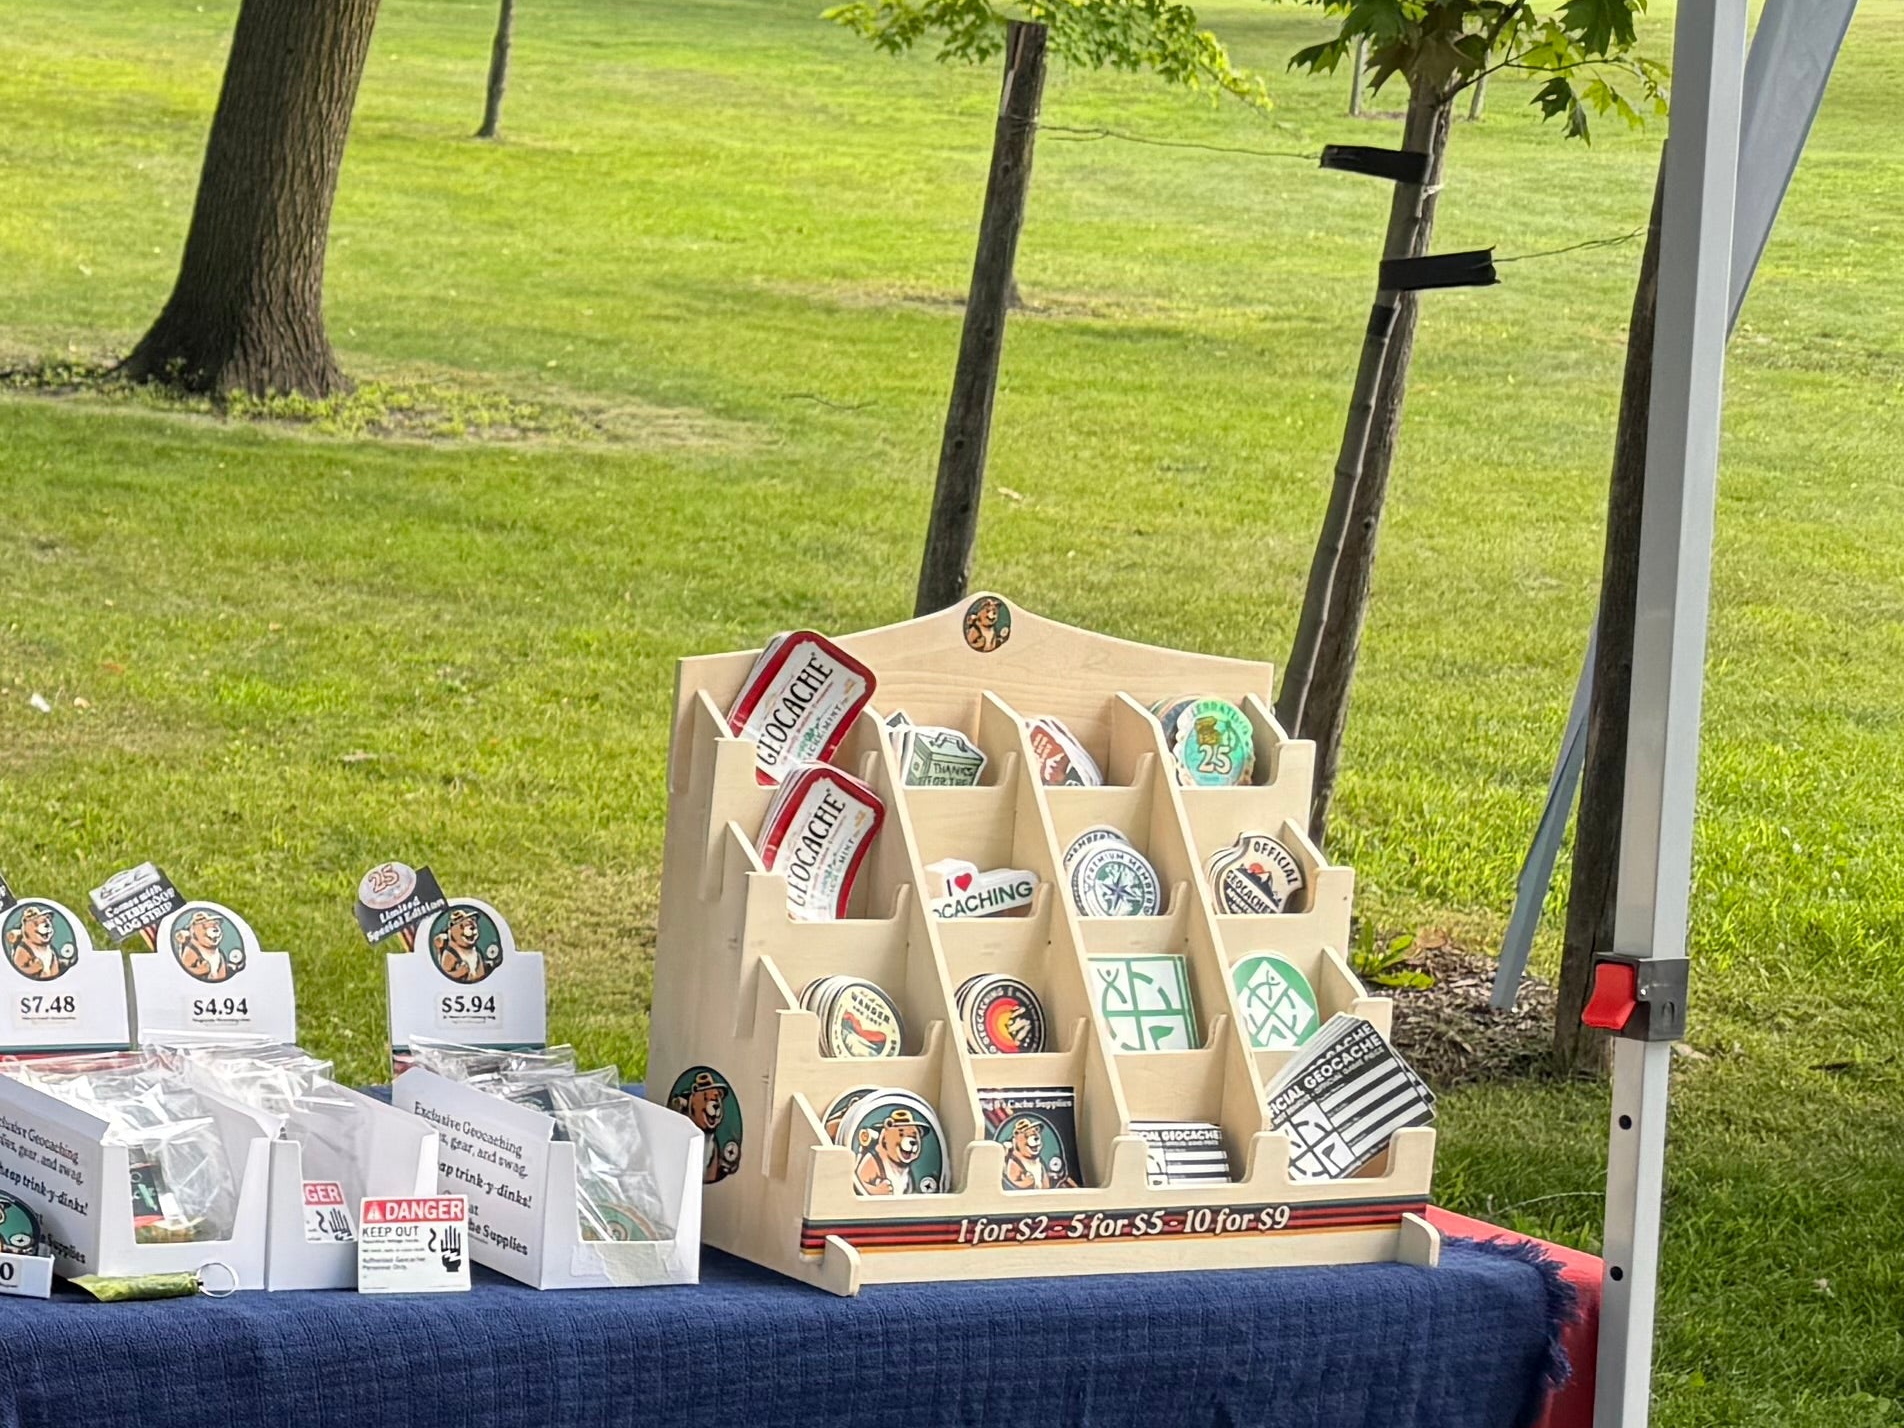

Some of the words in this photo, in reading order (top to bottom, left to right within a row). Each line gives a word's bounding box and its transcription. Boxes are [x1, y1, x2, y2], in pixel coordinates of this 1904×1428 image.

[756, 656, 834, 766] GEOCACHE
[933, 762, 974, 777] THANKS
[1198, 744, 1233, 775] 25
[787, 793, 846, 907] GEOCACHE
[1253, 840, 1298, 885] OFFICIAL
[368, 864, 399, 894] 25
[1086, 852, 1124, 880] PREMIUM
[933, 880, 1034, 918] CACHING
[946, 879, 953, 897] I
[366, 915, 404, 943] Special
[403, 898, 446, 927] Edition
[379, 895, 421, 924] Limited
[21, 996, 75, 1015] $7.48
[193, 998, 248, 1016] $4.94
[441, 995, 496, 1014] $5.94
[850, 991, 891, 1024] WANDER
[1303, 1034, 1382, 1090] GEOCACHE
[1007, 1100, 1034, 1110] Cache
[1035, 1099, 1073, 1110] Supplies
[414, 1101, 461, 1132] Exclusive
[462, 1121, 523, 1159] Geocaching
[1161, 1129, 1221, 1141] GEOCACHE
[28, 1129, 79, 1166] Geocaching
[304, 1183, 341, 1203] GER
[385, 1200, 463, 1220] DANGER
[362, 1227, 391, 1237] KEEP
[395, 1225, 420, 1237] OUT
[483, 1224, 529, 1256] Supplies
[957, 1220, 967, 1243] 1
[971, 1218, 1013, 1246] for
[1016, 1216, 1048, 1243] $2
[1067, 1214, 1087, 1239] 5
[1089, 1213, 1130, 1240] for
[1132, 1210, 1165, 1237] $5
[1183, 1209, 1211, 1233] 10
[1213, 1207, 1255, 1236] for
[1257, 1205, 1290, 1232] $9
